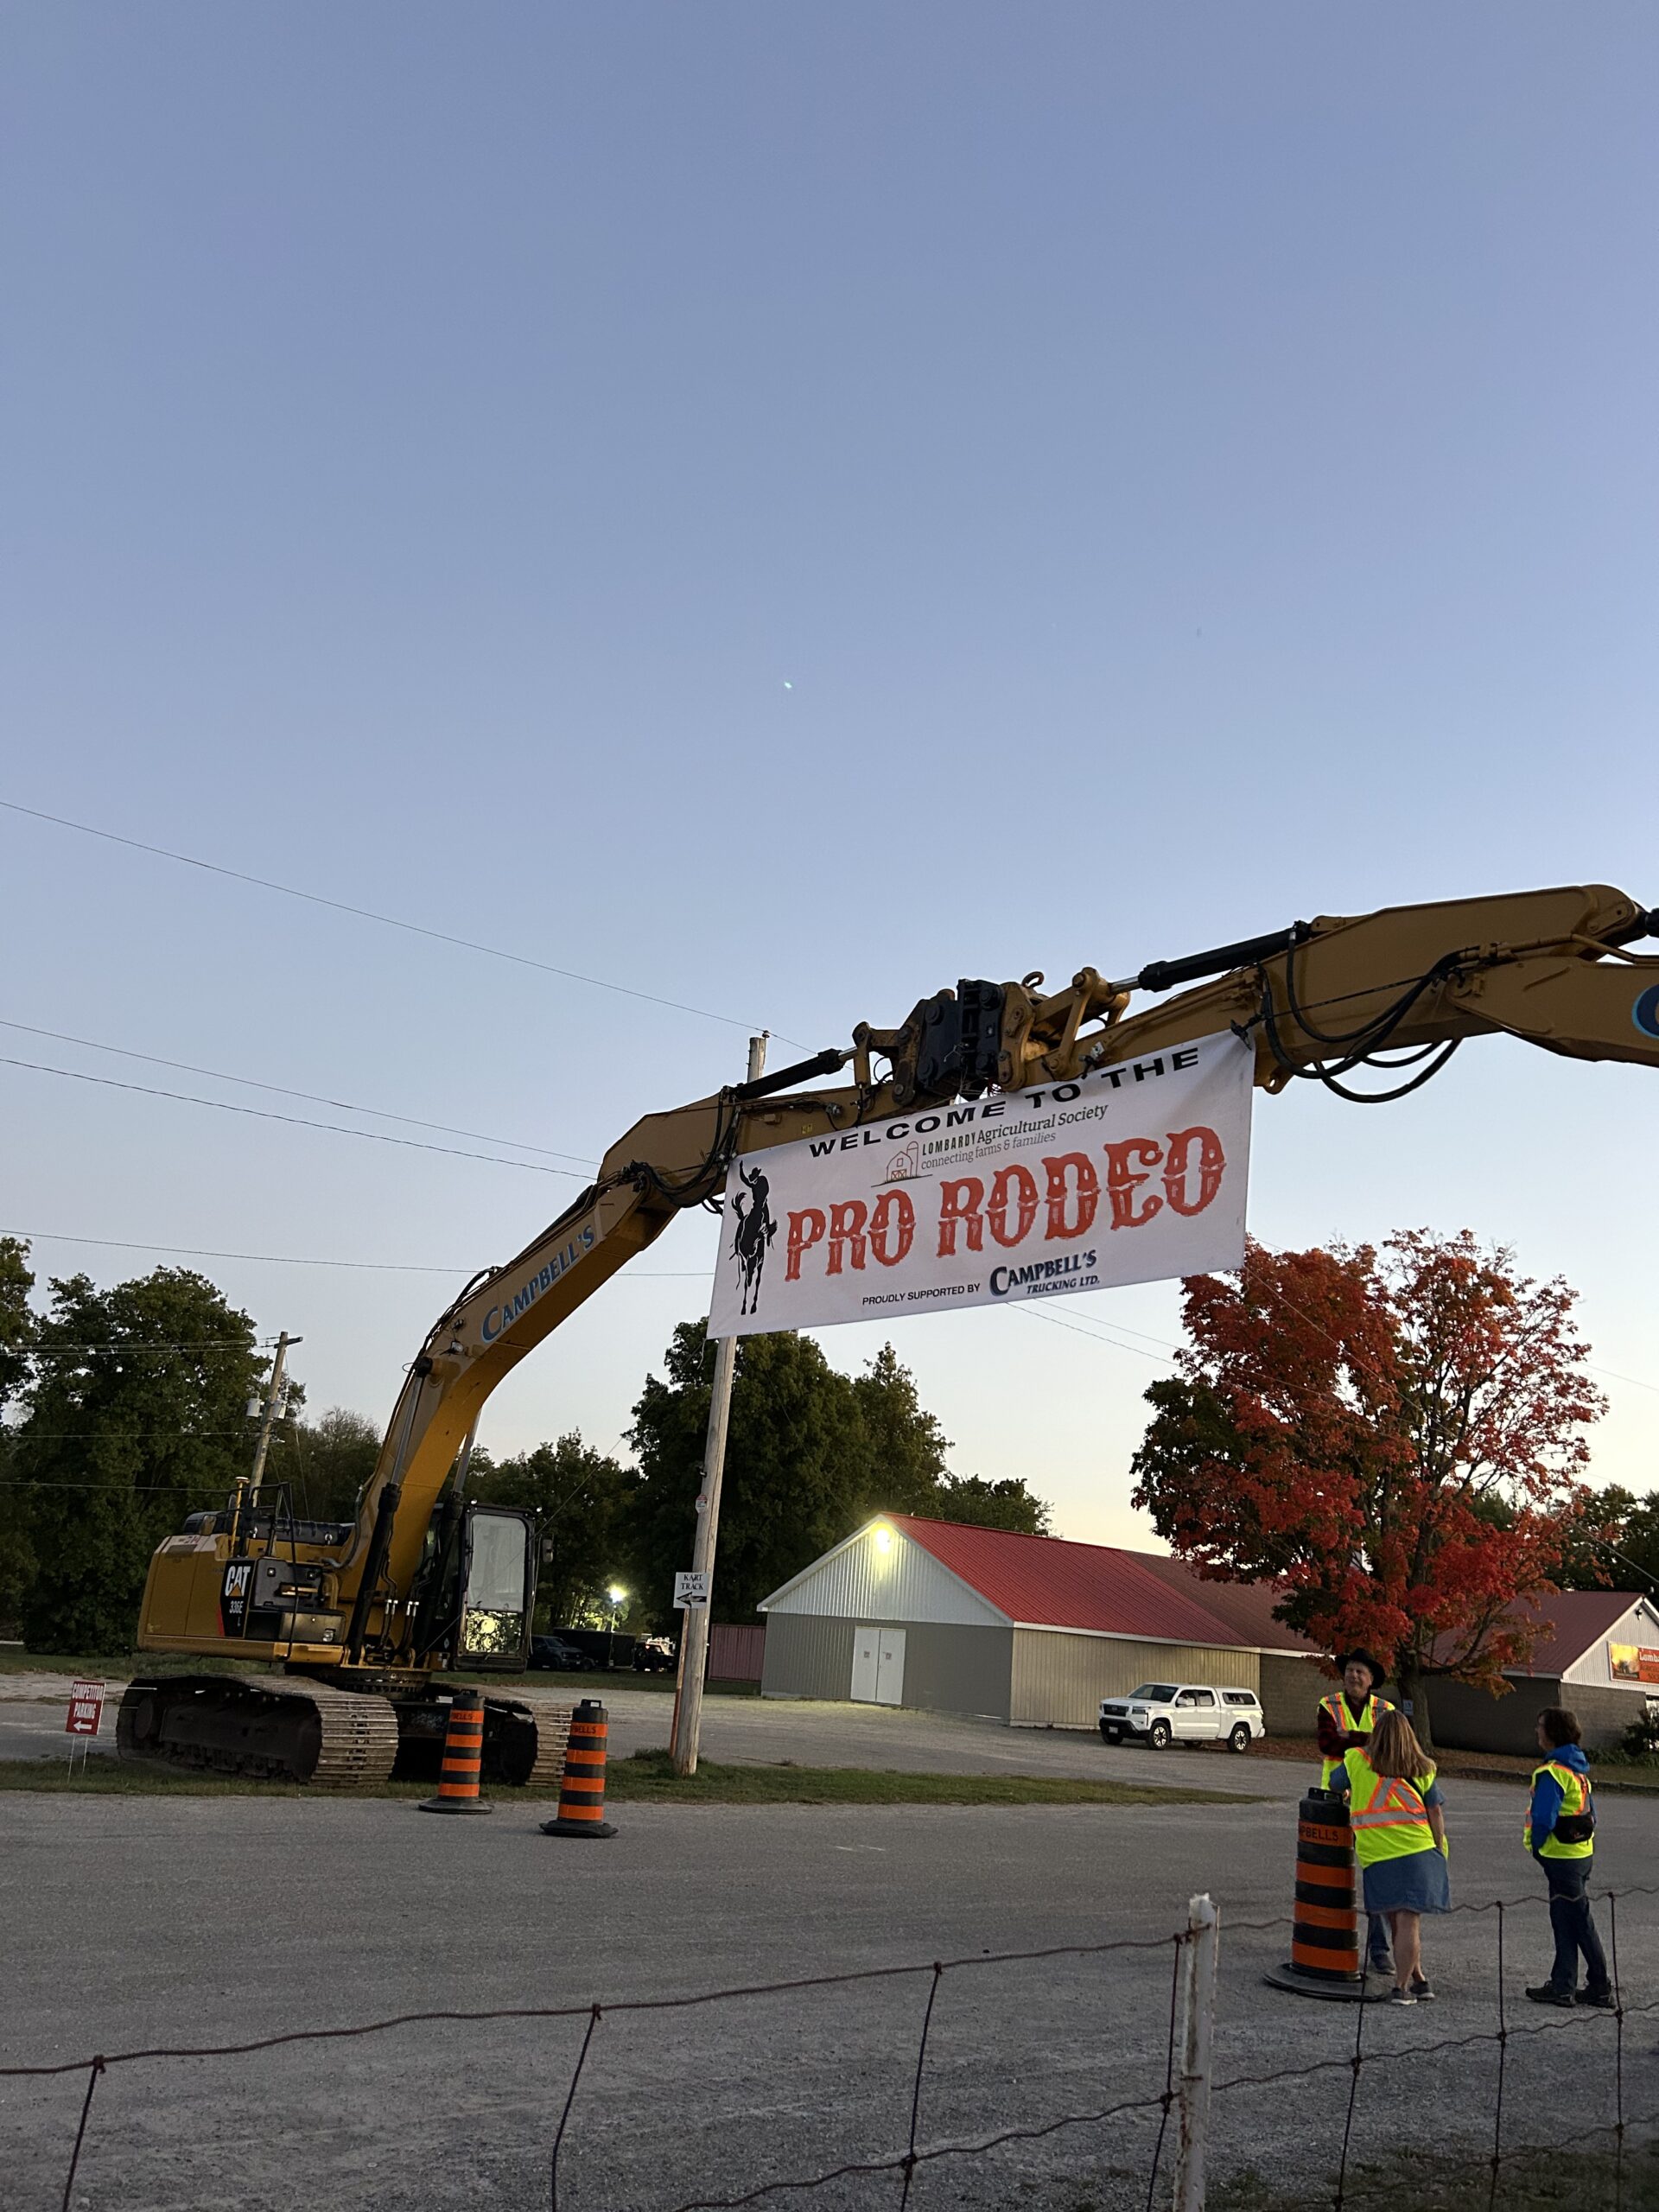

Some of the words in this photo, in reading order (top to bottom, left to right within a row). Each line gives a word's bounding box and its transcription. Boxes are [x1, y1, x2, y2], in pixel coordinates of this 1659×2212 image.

[809, 1101, 1007, 1158] WELCOME
[1025, 1083, 1081, 1109] TO
[1101, 1047, 1198, 1089] THE
[922, 1132, 976, 1156] LOMBARDY
[976, 1114, 1056, 1144] Agricultural
[1058, 1103, 1109, 1126] Society
[921, 1149, 974, 1170] connecting
[975, 1144, 1001, 1163] farms
[1003, 1139, 1010, 1150] &
[1012, 1130, 1056, 1150] families
[784, 1189, 916, 1282] PRO
[936, 1125, 1227, 1258] RODEO
[481, 1224, 595, 1344] CAMPBELL'S
[989, 1249, 1097, 1296] CAMPBELL'S
[1027, 1278, 1077, 1294] TRUCKING
[1079, 1274, 1100, 1287] LTD.
[862, 1292, 906, 1306] PROUDLY
[907, 1286, 965, 1300] SUPPORTED
[967, 1283, 981, 1294] BY
[225, 1566, 251, 1597] CAT
[683, 1573, 703, 1582] KART
[229, 1600, 244, 1614] 336E
[73, 1702, 97, 1719] PARKING
